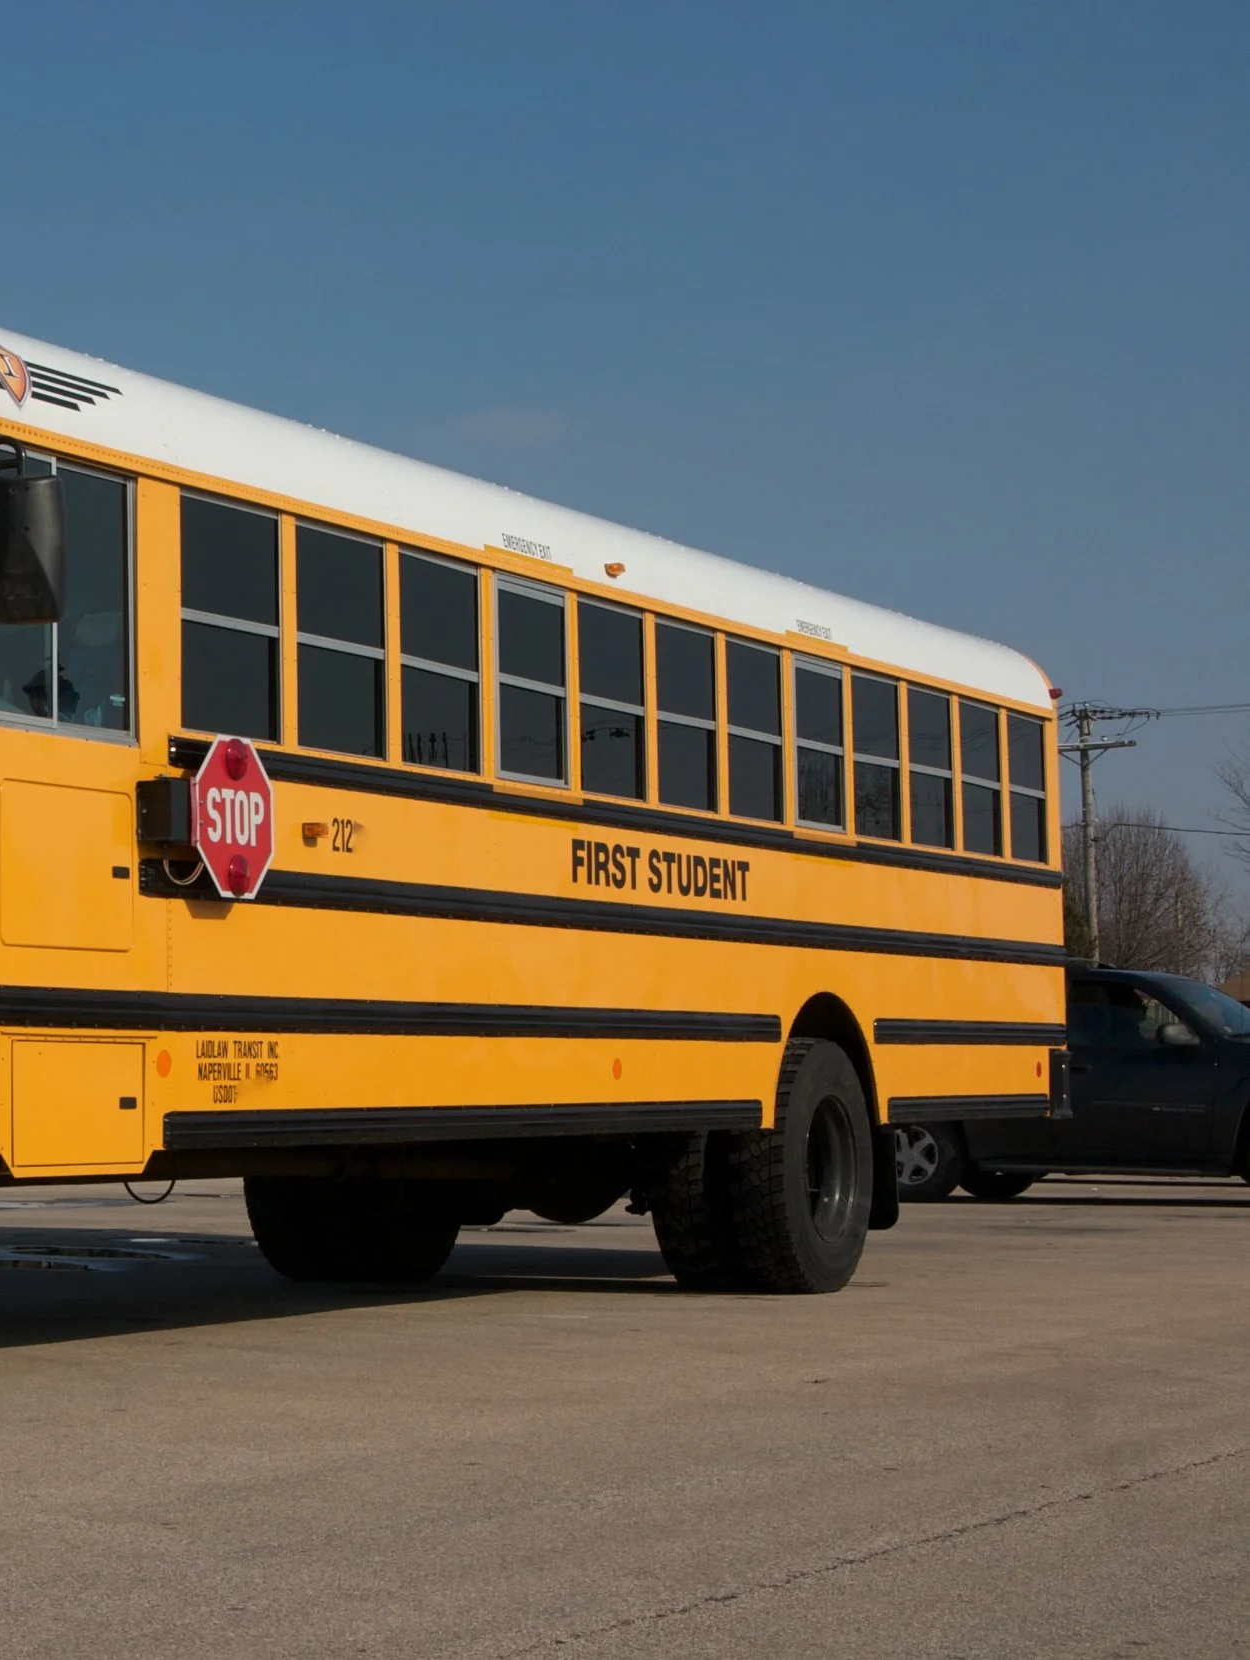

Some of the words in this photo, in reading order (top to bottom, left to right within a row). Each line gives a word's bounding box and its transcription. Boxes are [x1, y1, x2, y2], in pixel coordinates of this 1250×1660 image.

[502, 533, 539, 557] EMERGENCY
[538, 544, 553, 561] EXIT
[206, 787, 264, 846] STOP
[332, 817, 353, 853] 212
[572, 838, 640, 890] FIRST
[648, 848, 750, 902] STUDENT
[196, 1040, 228, 1059] LAIDLAW
[233, 1040, 263, 1059] TRANSIT
[197, 1062, 241, 1081] NAPERVILLE
